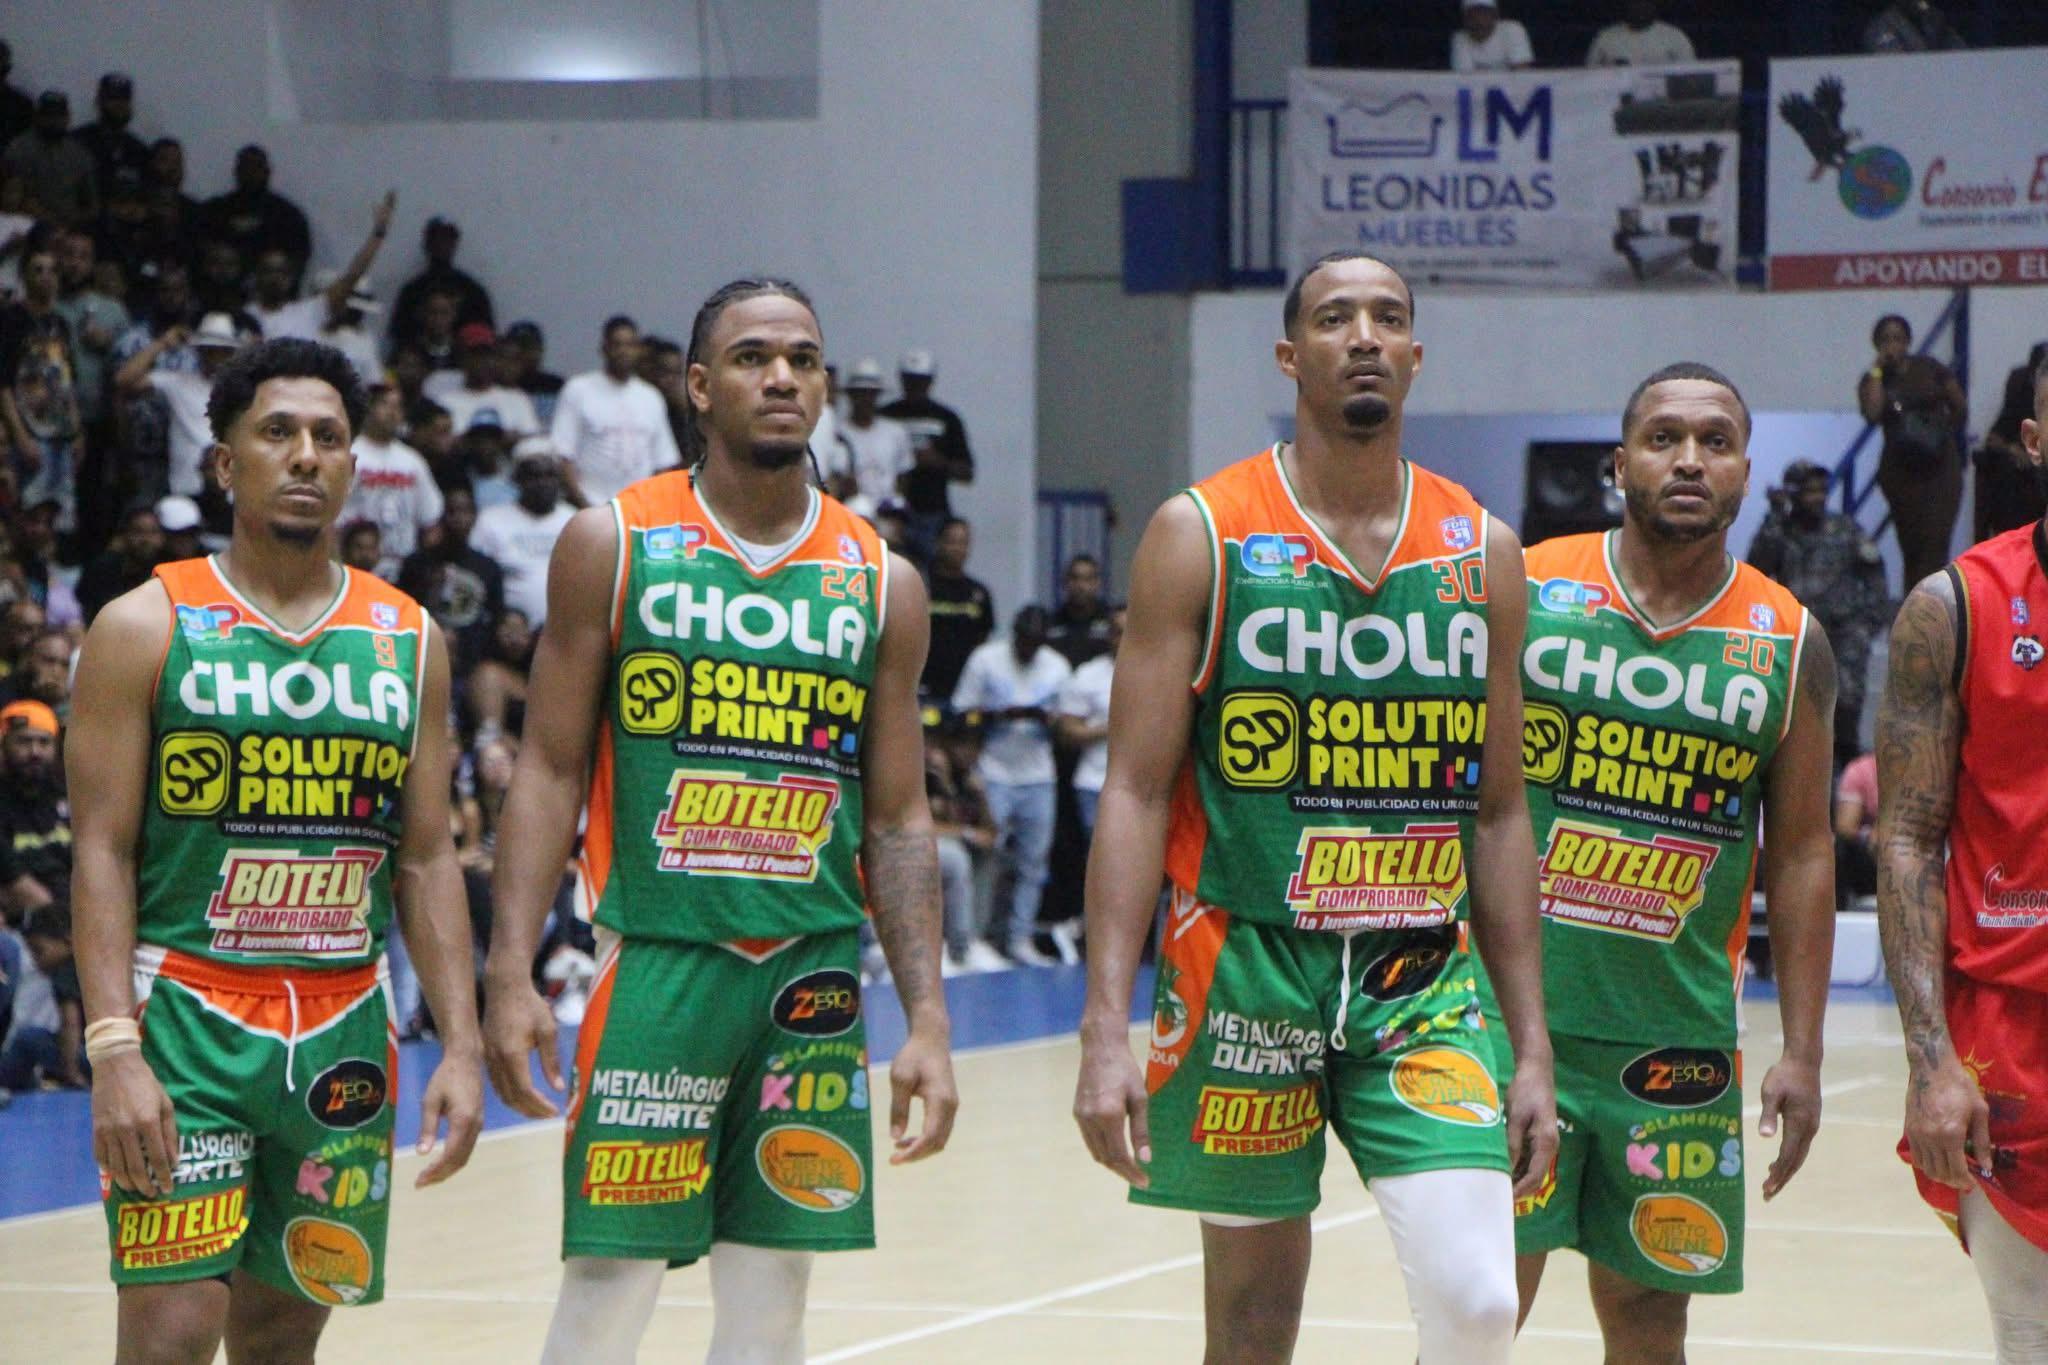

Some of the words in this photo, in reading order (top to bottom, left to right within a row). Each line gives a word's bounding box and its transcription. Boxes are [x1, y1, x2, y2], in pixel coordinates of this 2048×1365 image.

[1457, 86, 1553, 162] LM
[1321, 171, 1555, 212] LEONIDAS
[1358, 216, 1518, 247] MUEBLES
[1834, 256, 2003, 284] APOYANDO
[820, 564, 868, 606] 24
[1432, 558, 1488, 604] 30
[638, 581, 867, 666] CHOLA
[1237, 607, 1488, 680] CHOLA
[373, 634, 397, 670] 9
[1722, 631, 1776, 678] 20
[179, 660, 410, 732] CHOLA
[1523, 635, 1768, 735] CHOLA
[690, 698, 810, 746] PRINT
[676, 742, 707, 754] TODO
[709, 744, 725, 755] EN
[728, 745, 793, 763] PUBLICIDAD
[1309, 744, 1440, 788] PRINT
[238, 777, 353, 816] PRINT
[1570, 752, 1693, 809] PRINT
[674, 782, 829, 834] BOTELLO
[1294, 796, 1329, 808] TODO
[1348, 798, 1420, 810] PUBLICIDAD
[1422, 799, 1439, 810] EN
[1556, 793, 1584, 808] TODO
[1586, 800, 1602, 812] EN
[1604, 803, 1669, 825] PUBLICIDAD
[1671, 816, 1687, 828] EN
[1687, 819, 1701, 832] UN
[224, 822, 256, 833] TODO
[258, 823, 276, 834] EN
[277, 823, 343, 836] PUBLICIDAD
[681, 828, 798, 851] COMPROBADO
[1306, 838, 1462, 885] BOTELLO
[1548, 831, 1702, 896] BOTELLO
[1315, 889, 1428, 909] COMPROBADO
[1550, 899, 1613, 924] Juventud
[1552, 876, 1667, 912] COMPROBADO
[235, 909, 353, 929] COMPROBADO
[1151, 1049, 1179, 1068] OLA
[1643, 1060, 1715, 1092] ZERO
[760, 1069, 868, 1112] KIDS
[597, 1098, 716, 1130] DUARTE
[588, 1141, 705, 1185] BOTELLO
[1626, 1138, 1741, 1182] KIDS
[296, 1159, 388, 1209] KIDS
[121, 1188, 243, 1248] BOTELLO
